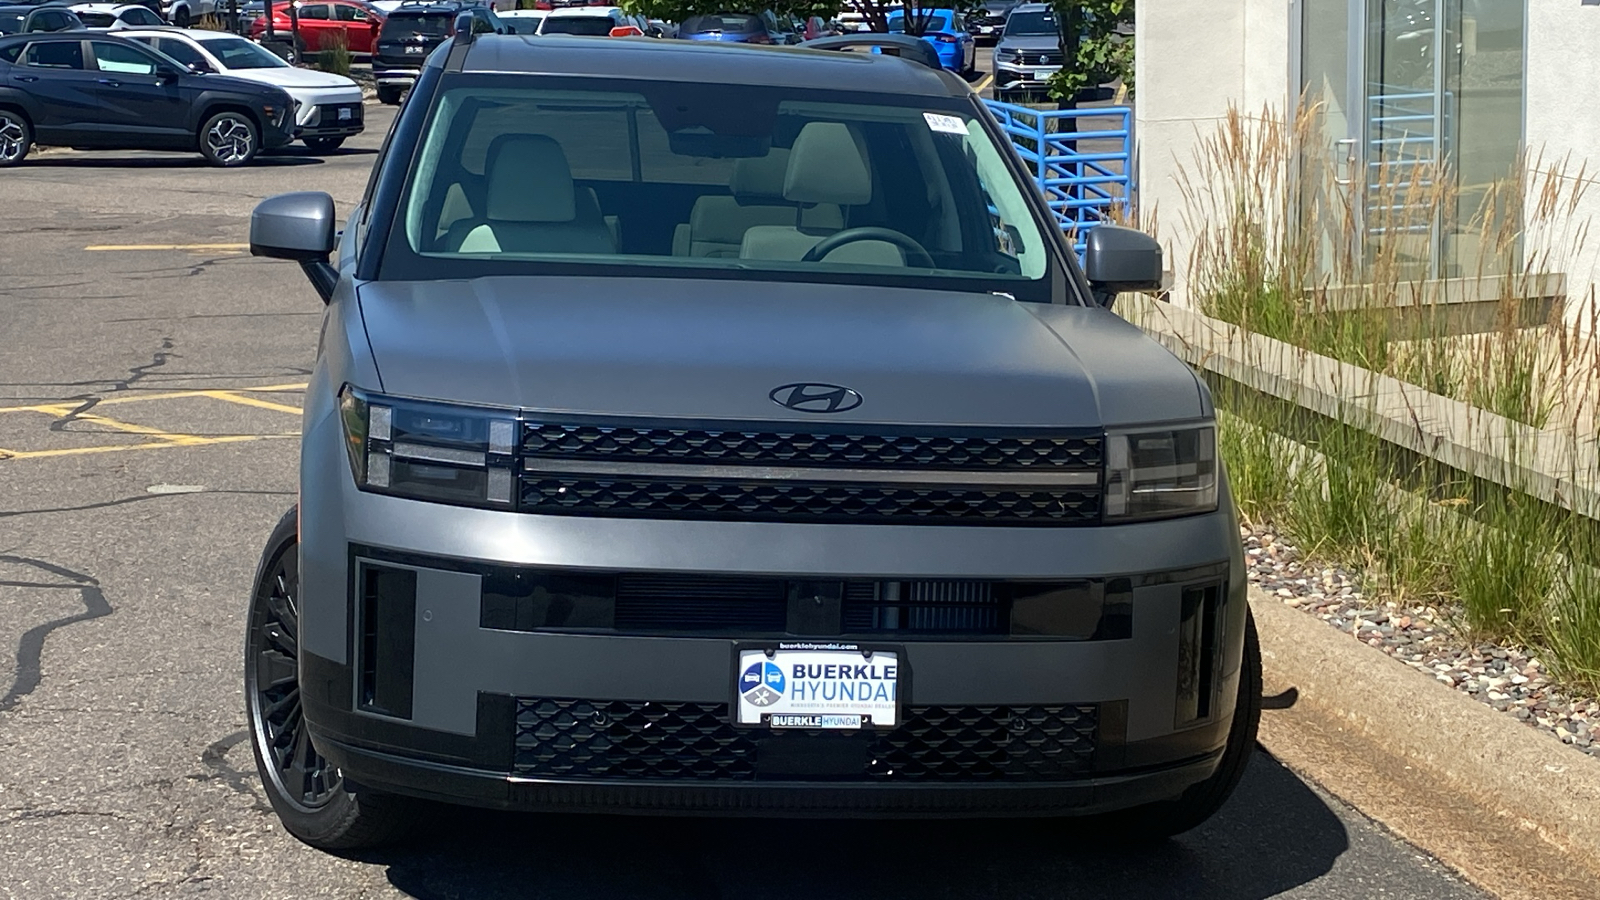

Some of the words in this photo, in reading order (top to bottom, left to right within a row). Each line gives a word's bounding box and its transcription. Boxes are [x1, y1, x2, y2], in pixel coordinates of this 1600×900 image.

[779, 642, 858, 650] buerklehyundai.com
[792, 664, 897, 680] BUERKLE
[791, 681, 896, 702] HYUNDAI
[772, 716, 822, 726] BUERKLE
[823, 717, 860, 726] HYUNDAI
